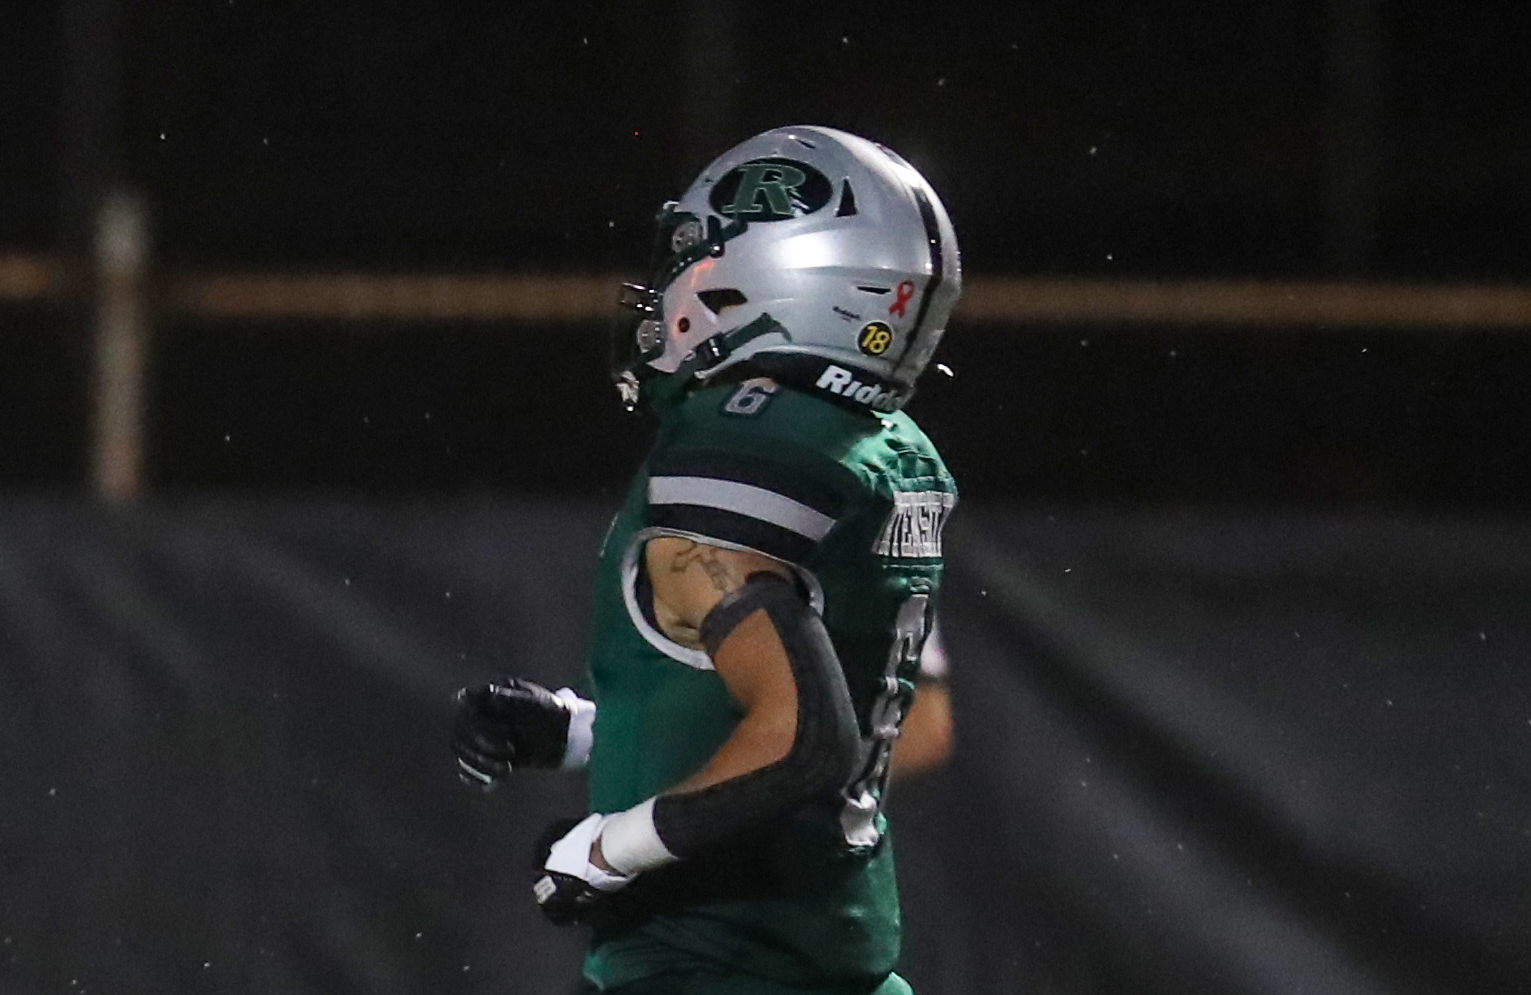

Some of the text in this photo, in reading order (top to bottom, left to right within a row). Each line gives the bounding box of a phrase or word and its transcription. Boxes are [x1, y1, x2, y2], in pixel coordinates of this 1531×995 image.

[722, 162, 807, 217] R
[860, 324, 892, 354] 18
[724, 377, 780, 415] 6
[815, 364, 905, 412] Ridd
